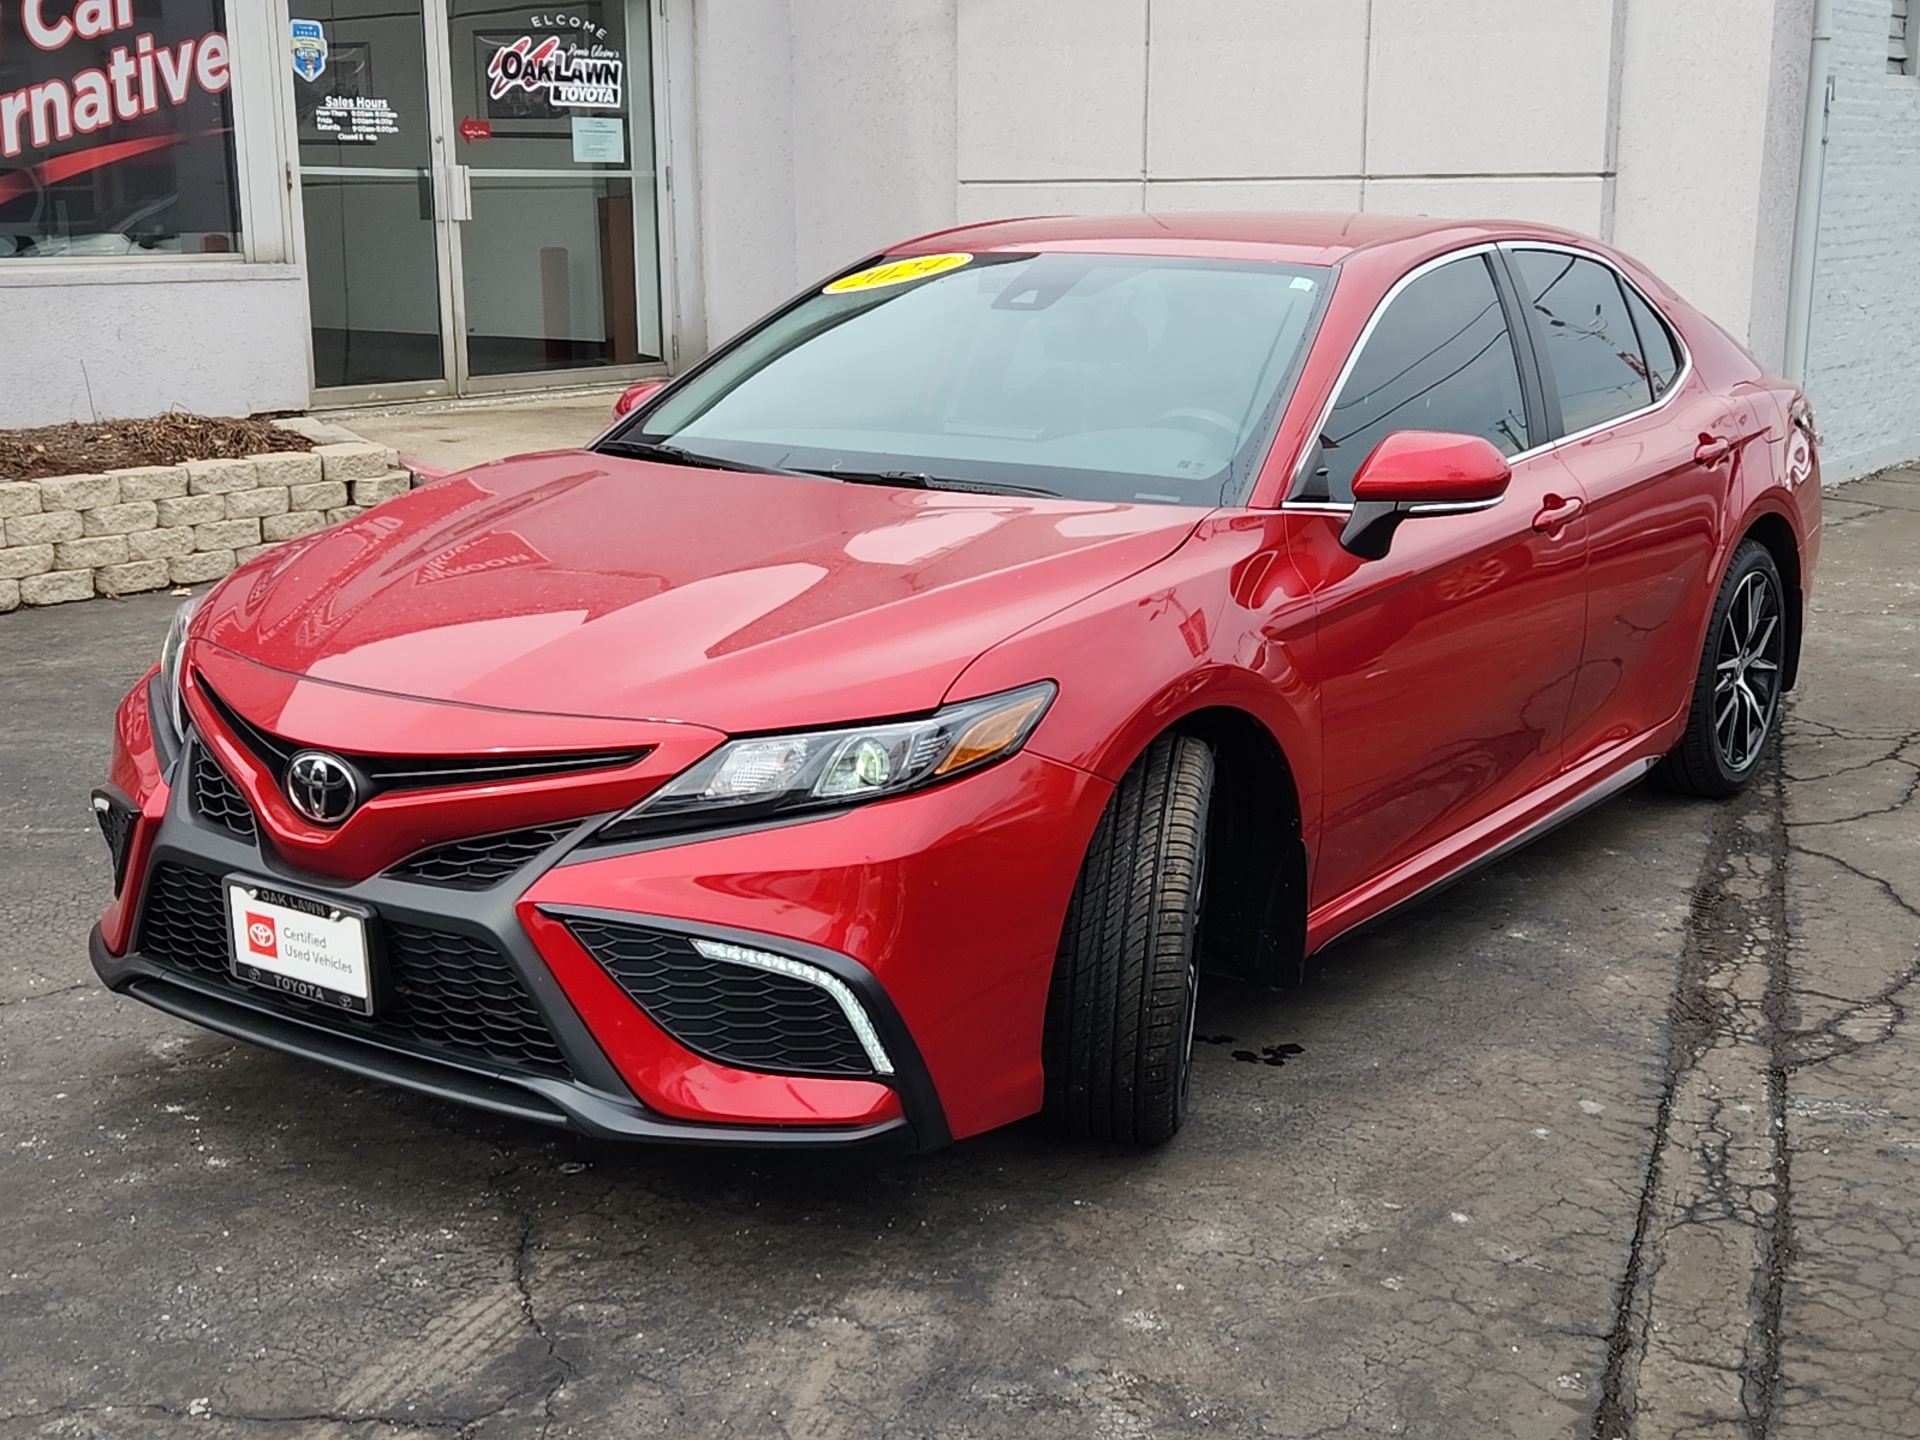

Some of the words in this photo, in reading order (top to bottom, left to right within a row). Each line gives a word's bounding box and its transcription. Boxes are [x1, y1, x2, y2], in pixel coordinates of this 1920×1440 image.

[325, 95, 354, 108] Sales
[356, 96, 388, 109] Hours
[559, 87, 614, 102] TOYOTA
[261, 889, 288, 907] OAK
[289, 895, 326, 917] LAWN
[283, 926, 327, 949] Certified
[284, 944, 311, 962] Used
[311, 950, 354, 974] Vehicles
[273, 974, 325, 1001] TOYOTA
